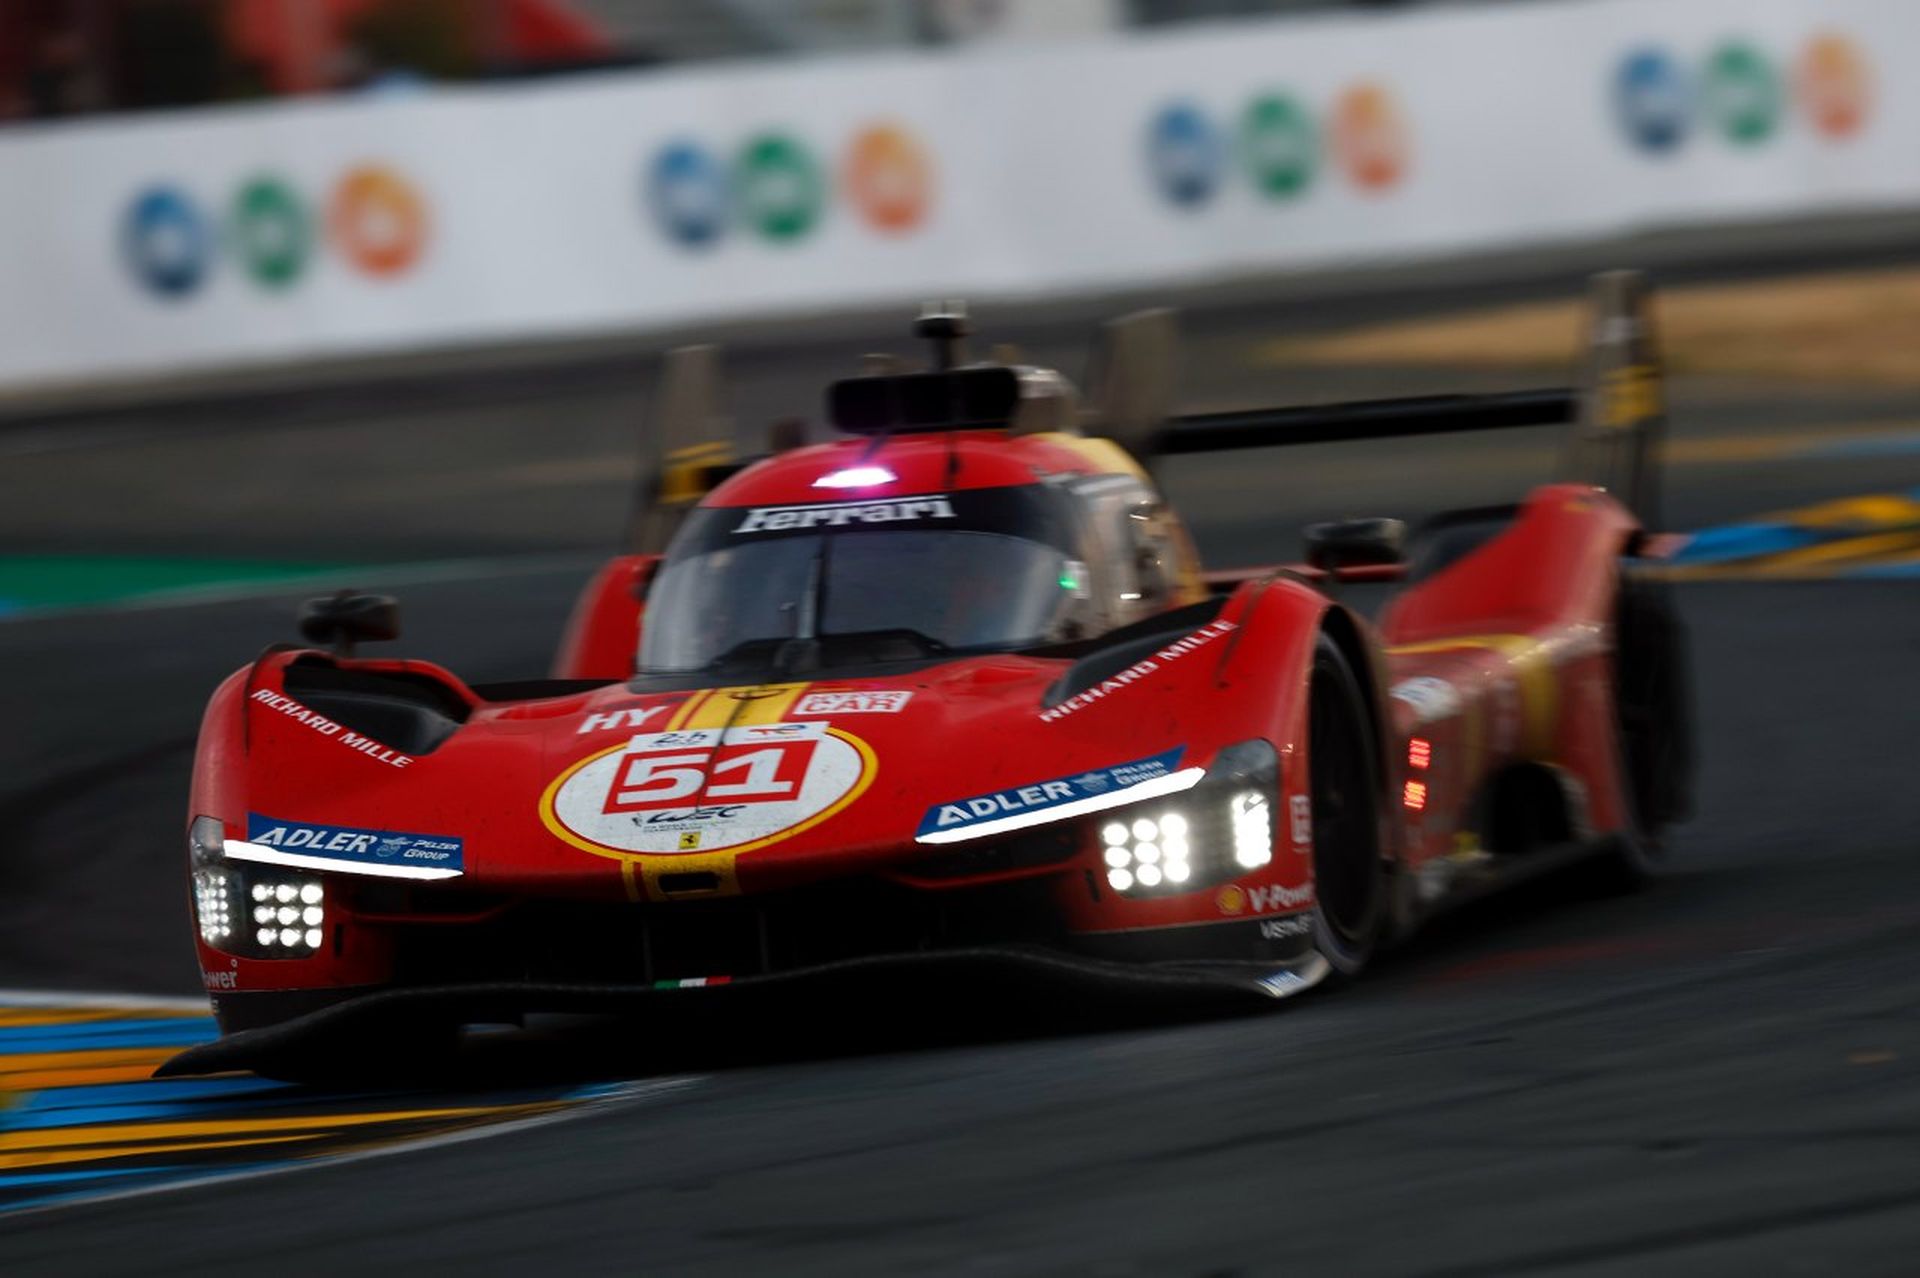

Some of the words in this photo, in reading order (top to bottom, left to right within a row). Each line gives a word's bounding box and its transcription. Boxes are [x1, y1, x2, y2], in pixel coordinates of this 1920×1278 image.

[731, 495, 957, 533] Ferrari
[1038, 660, 1161, 723] RICHARD
[1156, 618, 1240, 662] MILLE
[251, 688, 342, 735] RICHARD
[338, 729, 414, 768] MILLE
[577, 706, 668, 734] HY
[617, 748, 793, 804] 51
[936, 781, 1075, 827] ADLER
[250, 827, 378, 853] ADLER
[403, 848, 450, 860] GROUP
[413, 839, 460, 850] PELZER
